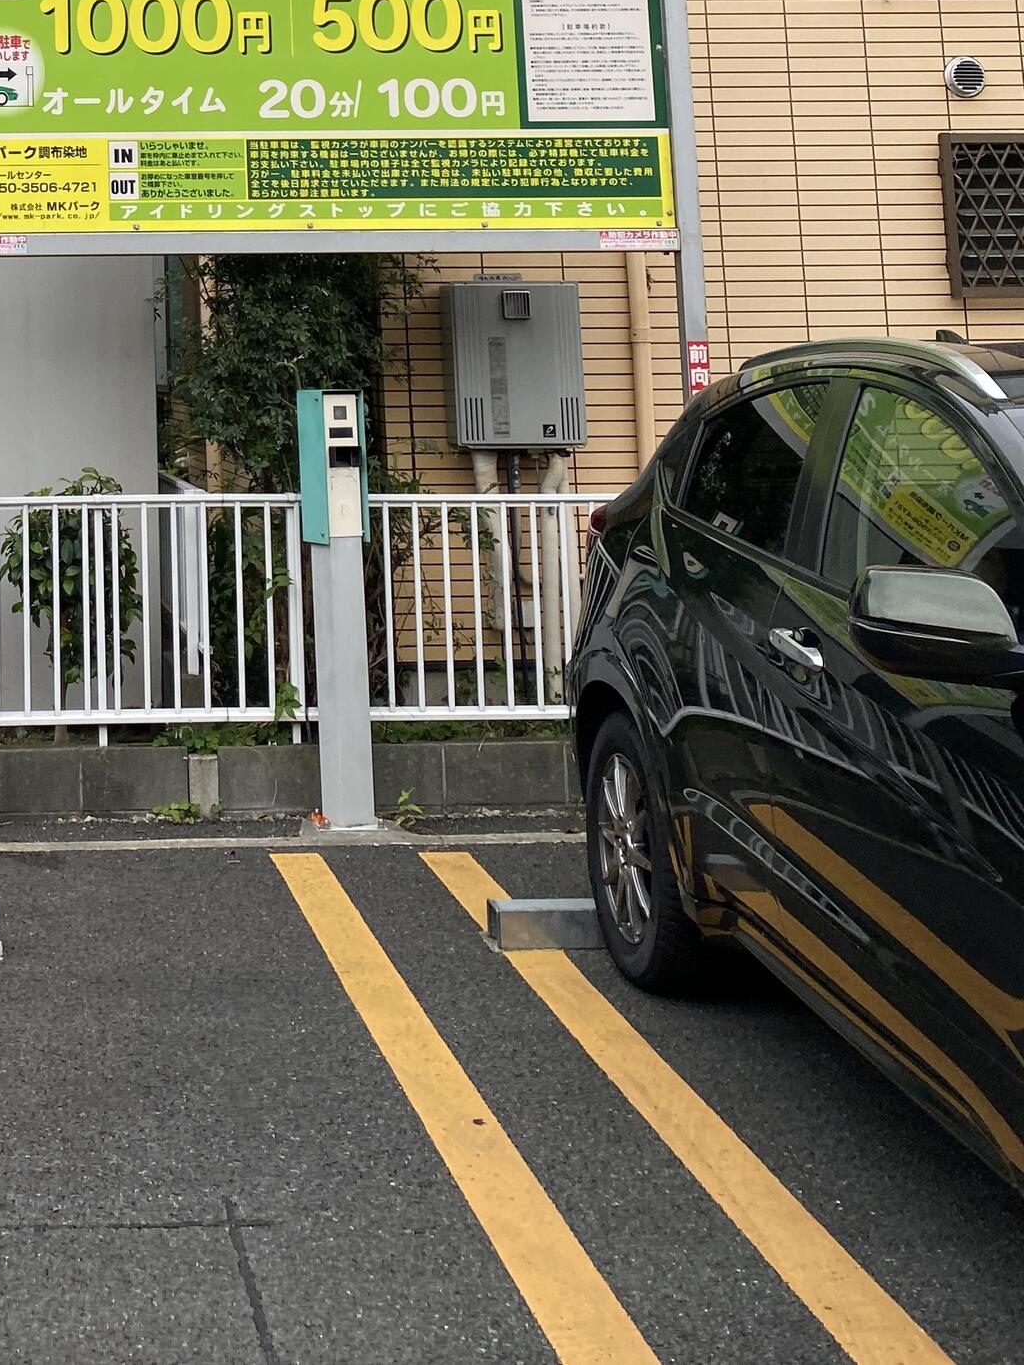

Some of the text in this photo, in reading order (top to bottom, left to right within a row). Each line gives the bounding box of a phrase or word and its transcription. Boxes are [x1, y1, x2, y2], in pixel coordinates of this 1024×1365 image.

[41, 86, 226, 116] オールタイム
[378, 77, 506, 118] 100円
[140, 141, 209, 151] いらっしゃいませ。
[114, 149, 133, 164] IN
[111, 179, 136, 195] OUT
[141, 189, 235, 199] ありがとうございました。
[10, 203, 43, 212] 株式会社
[47, 201, 100, 211] MKパーク
[608, 231, 677, 239] 防犯カメラ作動中
